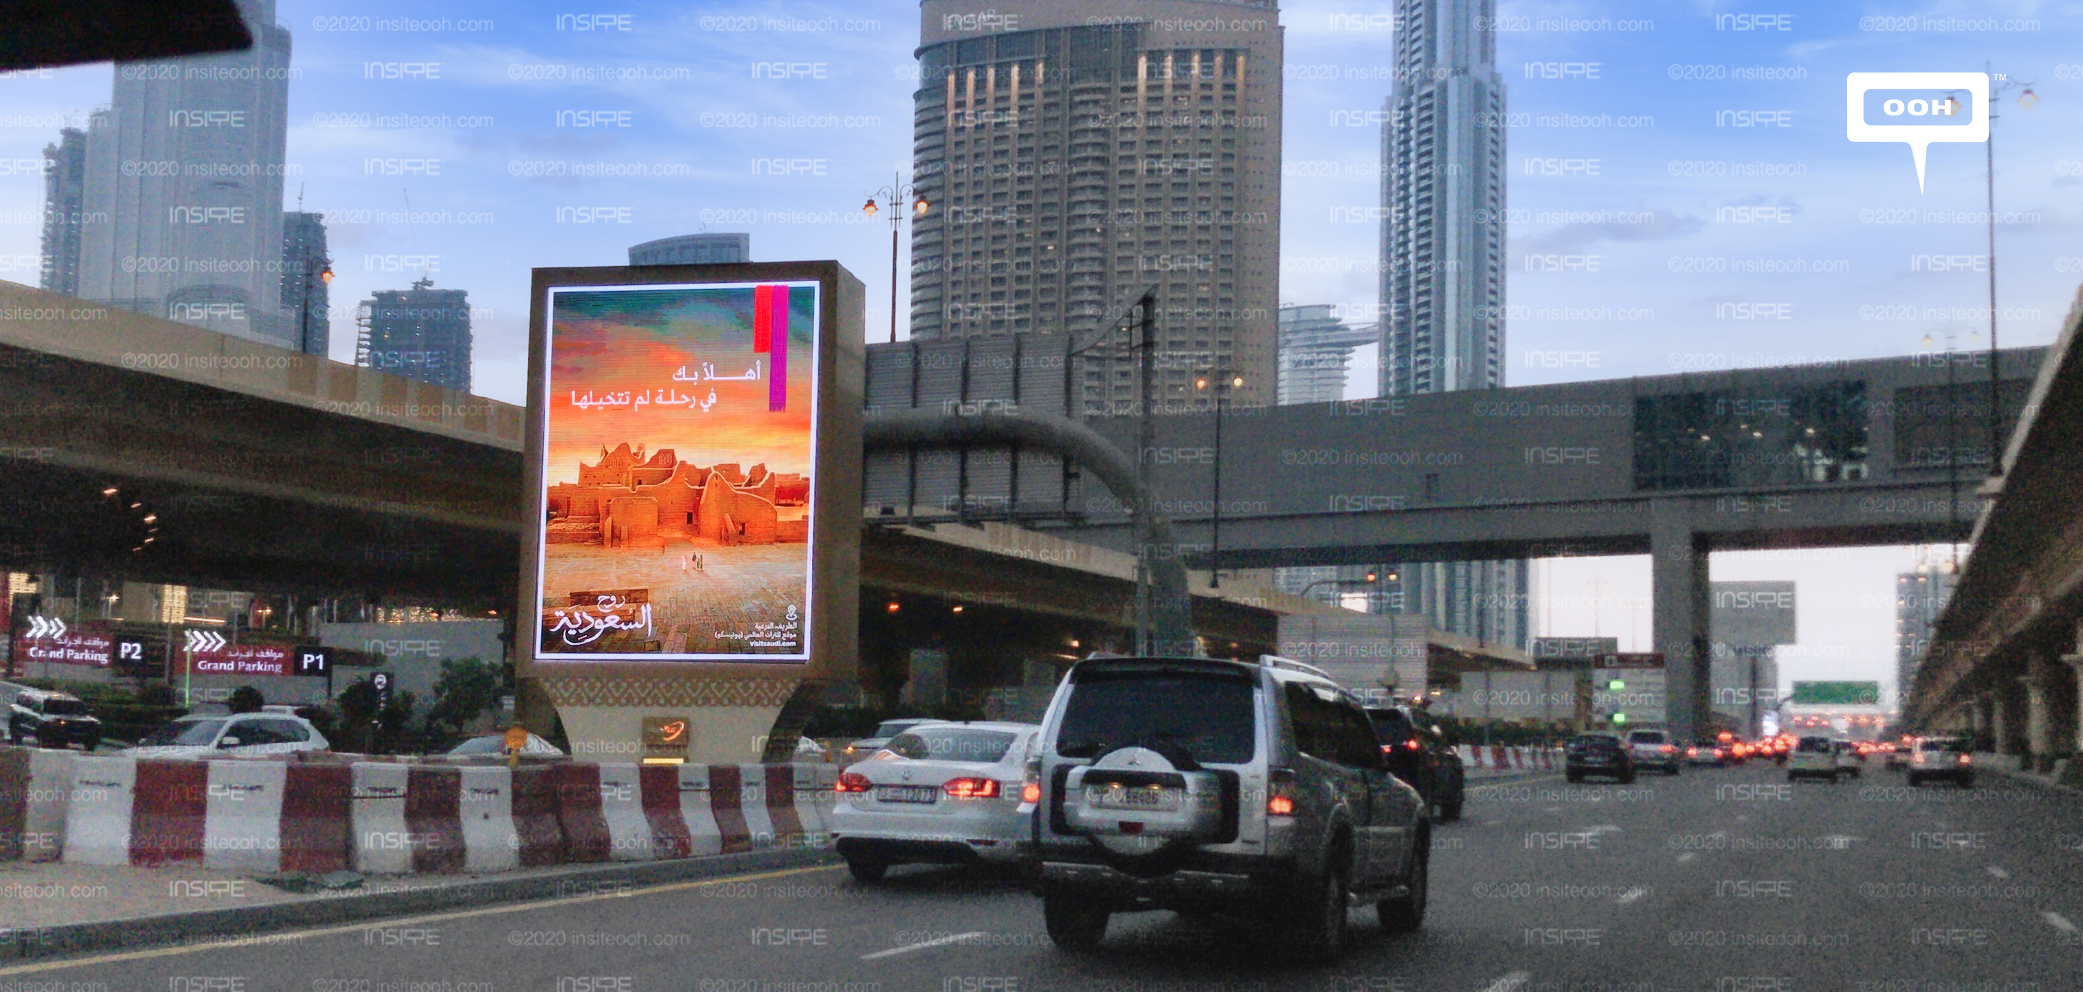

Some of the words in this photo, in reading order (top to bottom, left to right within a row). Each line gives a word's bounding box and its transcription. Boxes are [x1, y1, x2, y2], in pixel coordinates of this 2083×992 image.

[672, 365, 699, 386] بك
[571, 389, 630, 411] تتخيلها
[634, 389, 650, 412] لم
[654, 388, 697, 409] رحلة
[700, 387, 717, 412] في
[66, 649, 109, 664] Parking
[120, 641, 143, 660] P2
[197, 660, 235, 671] Grand
[237, 661, 283, 674] Parking
[302, 653, 325, 670] P1
